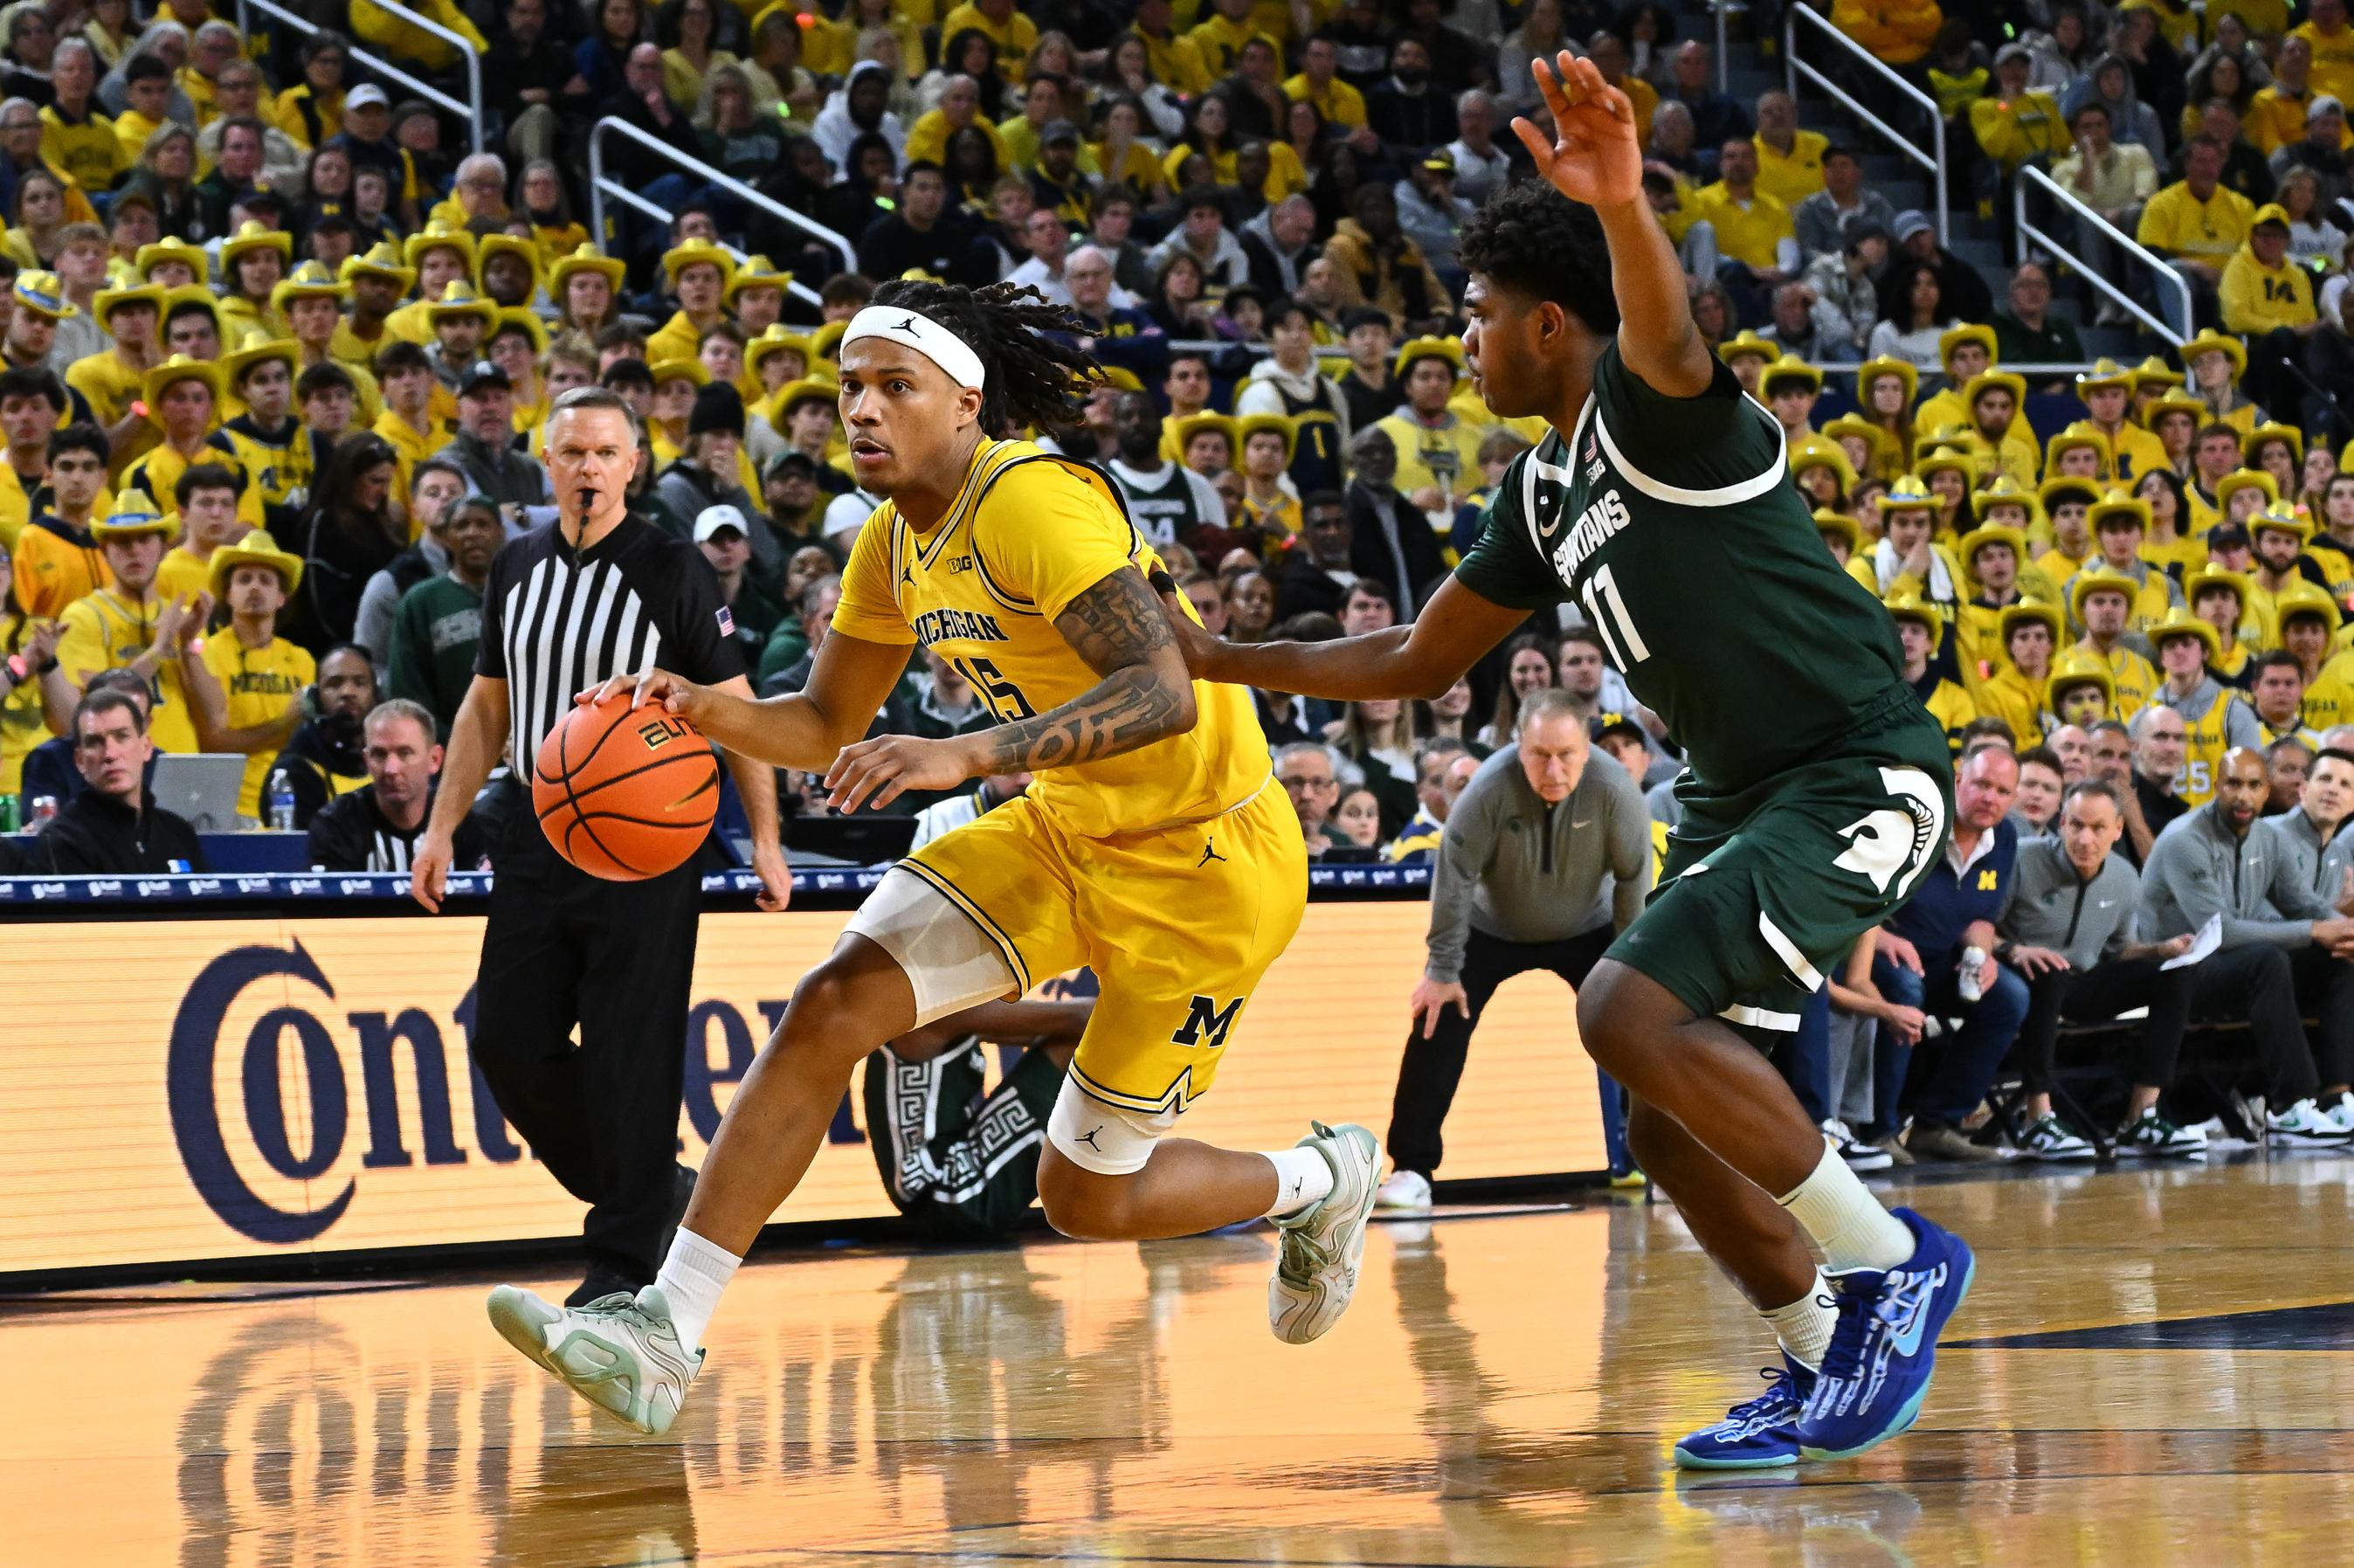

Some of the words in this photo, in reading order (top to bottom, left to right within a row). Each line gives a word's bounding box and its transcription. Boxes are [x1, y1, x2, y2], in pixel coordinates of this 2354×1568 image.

[1553, 488, 1631, 589] SPARTANS
[947, 556, 973, 575] BIG
[912, 608, 1011, 648] MICHIGAN
[1581, 563, 1651, 674] 11
[953, 656, 1038, 725] 15
[637, 716, 705, 750] ELIT
[1977, 869, 1998, 891] M
[1170, 993, 1245, 1048] M
